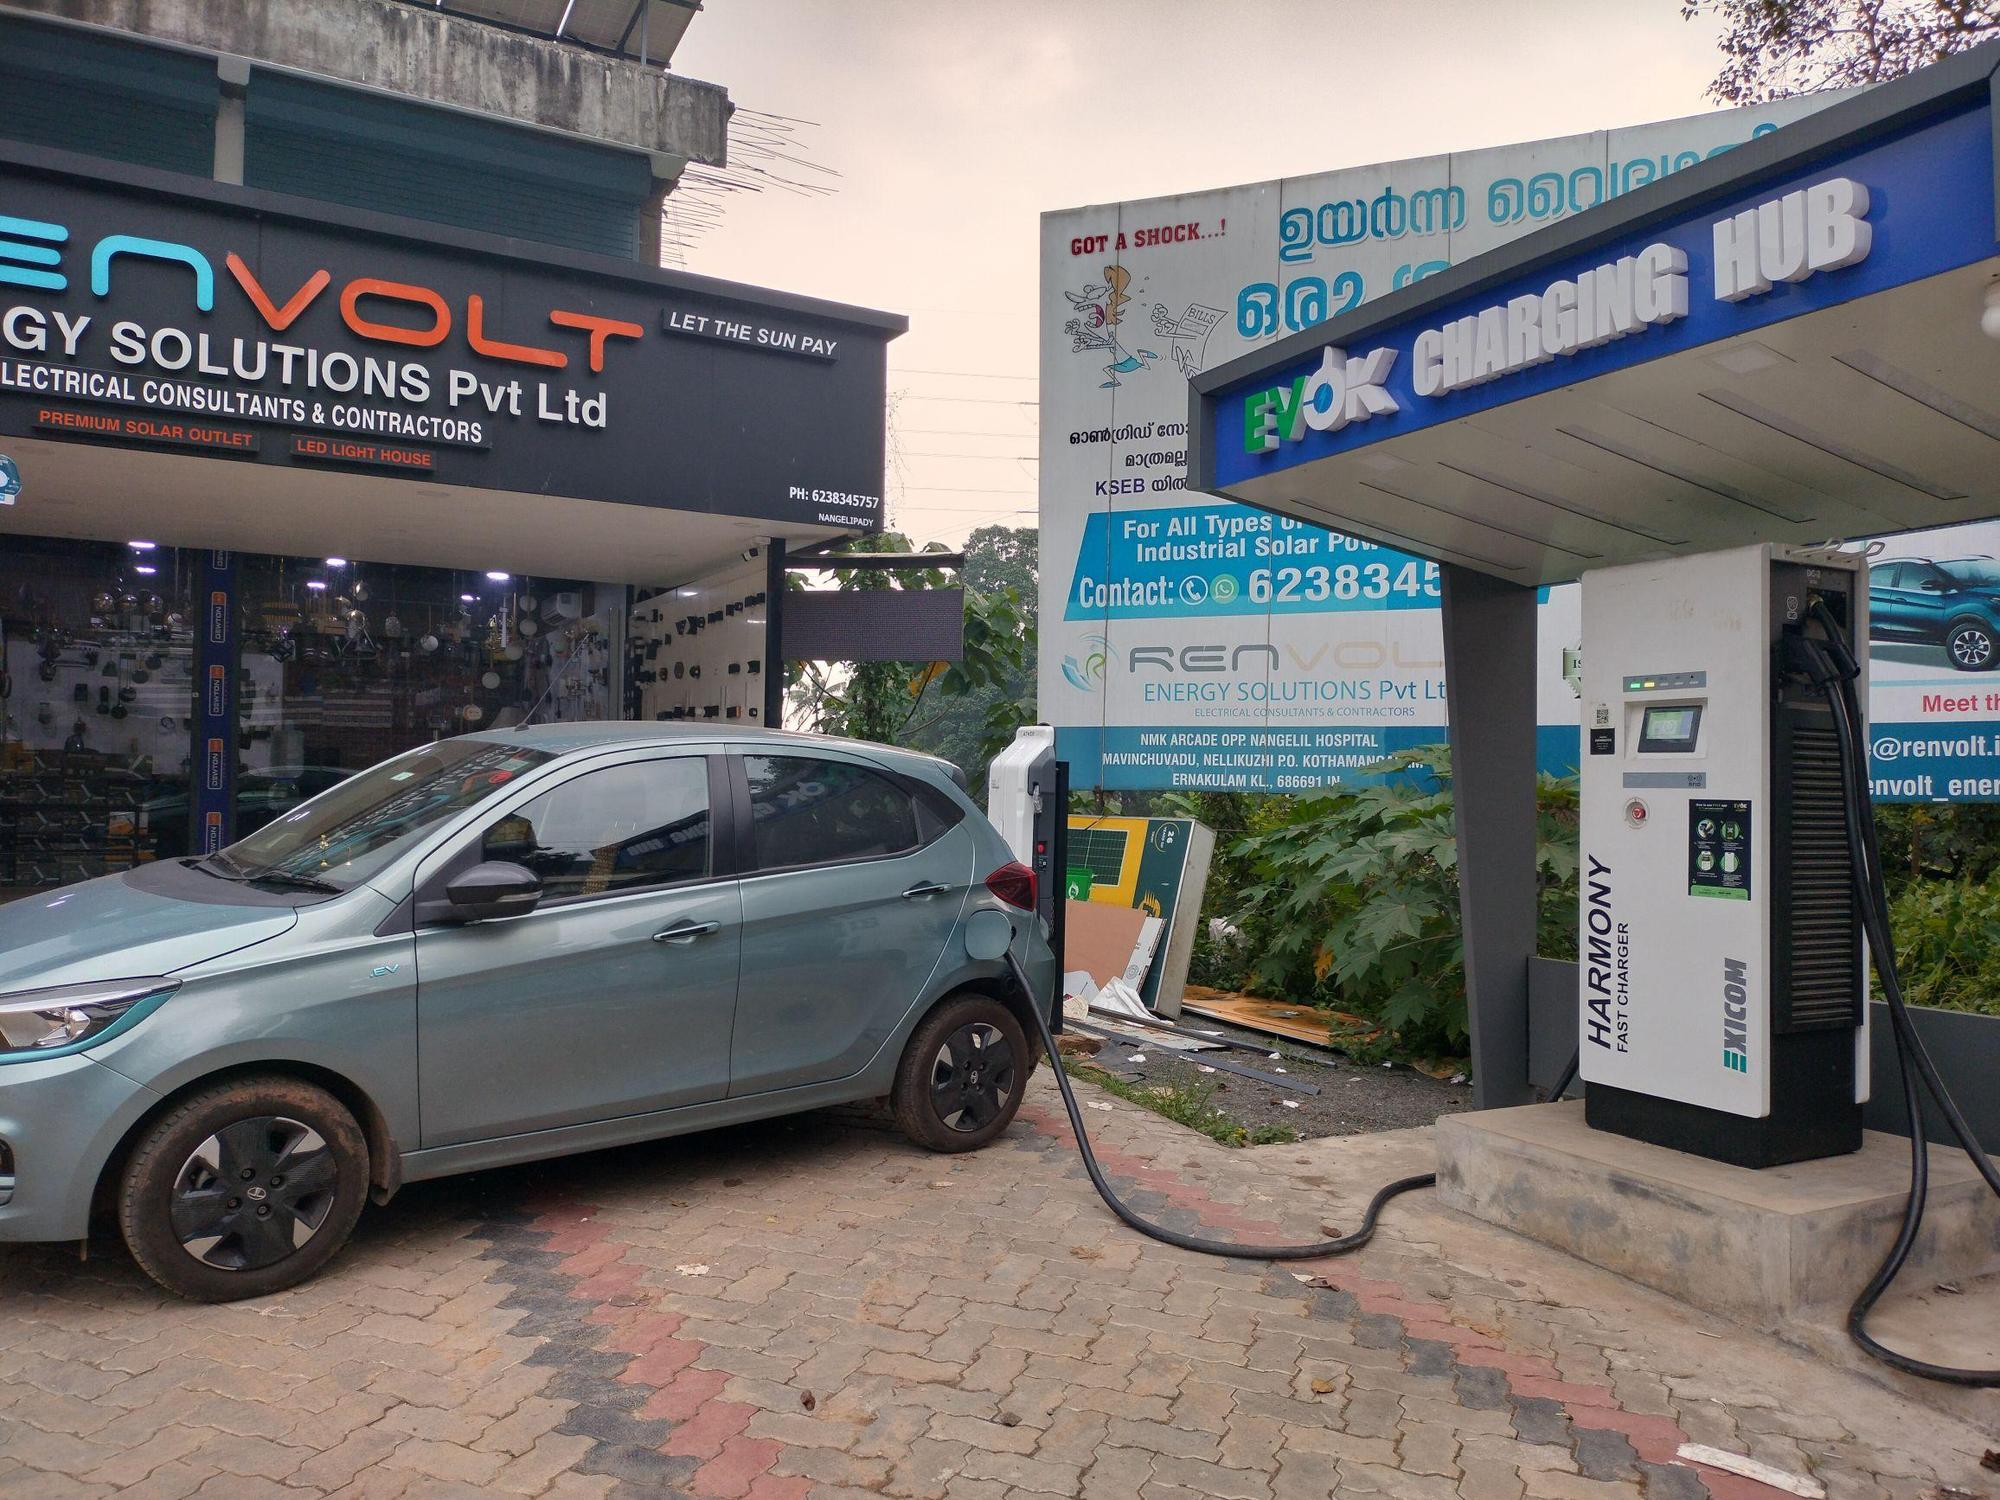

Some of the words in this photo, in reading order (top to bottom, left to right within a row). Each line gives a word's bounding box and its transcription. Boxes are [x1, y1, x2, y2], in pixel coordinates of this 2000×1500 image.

[1071, 234, 1109, 256] GOT
[1114, 233, 1127, 251] A
[1134, 218, 1227, 247] SHOCK...!
[1187, 307, 1216, 325] BILLS
[1245, 345, 1399, 453] EVOK
[1413, 243, 1688, 396] CHARGING
[1713, 177, 1871, 301] HUB
[669, 311, 708, 334] LET
[714, 320, 752, 341] THE
[757, 328, 796, 349] SUN
[800, 337, 837, 356] PAY
[2, 306, 91, 355] GY
[110, 321, 431, 402] SOLUTIONS
[448, 369, 522, 415] Pvt
[538, 383, 607, 428] Ltd
[2, 362, 136, 401] LECTRICAL
[143, 380, 305, 422] CONSULTANTS
[312, 404, 325, 423] &
[331, 406, 482, 443] CONTRACTORS
[40, 410, 120, 432] PREMIUM
[126, 419, 184, 440] SOLAR
[189, 426, 252, 447] OUTLET
[297, 440, 327, 455] LED
[332, 443, 376, 462] LIGHT
[380, 450, 431, 466] HOUSE
[789, 486, 809, 501] PH:
[812, 488, 879, 509] 6238345757
[1095, 478, 1145, 496] KSEB
[818, 513, 874, 527] NANGELIPADY
[1124, 520, 1159, 539] For
[1167, 516, 1196, 536] All
[1205, 513, 1272, 537] Types
[1137, 538, 1245, 562] Industrial
[1255, 534, 1319, 557] Solar
[1079, 575, 1174, 608] Contact:
[1250, 562, 1441, 604] 6238345
[1129, 640, 1444, 673] RENVOL
[1144, 683, 1230, 702] ENERGY
[1238, 680, 1371, 701] SOLUTIONS
[1380, 680, 1416, 700] Pvt
[1425, 679, 1446, 700] Lt
[1922, 695, 1978, 712] Meet
[1985, 693, 2000, 711] th
[1195, 707, 1250, 717] ELECTRICAL
[1253, 707, 1325, 717] CONSULTANTS
[1327, 707, 1334, 717] &
[1336, 706, 1415, 717] CONTRACTORS
[1140, 733, 1168, 747] NMK
[1170, 733, 1218, 747] ARCADE
[1250, 733, 1312, 747] NANGELIL
[1315, 733, 1378, 747] HOSPITAL
[1869, 735, 2000, 761] @renvolt.i
[1102, 752, 1199, 768] MAVINCHUVADU,
[1203, 752, 1275, 767] NELLIKUZHI
[1172, 773, 1248, 787] ERNAKULAM
[1277, 773, 1321, 788] 686691
[1588, 854, 1612, 1049] HARMONY
[1617, 922, 1629, 1006] CHARGER
[1617, 1010, 1628, 1053] FAST
